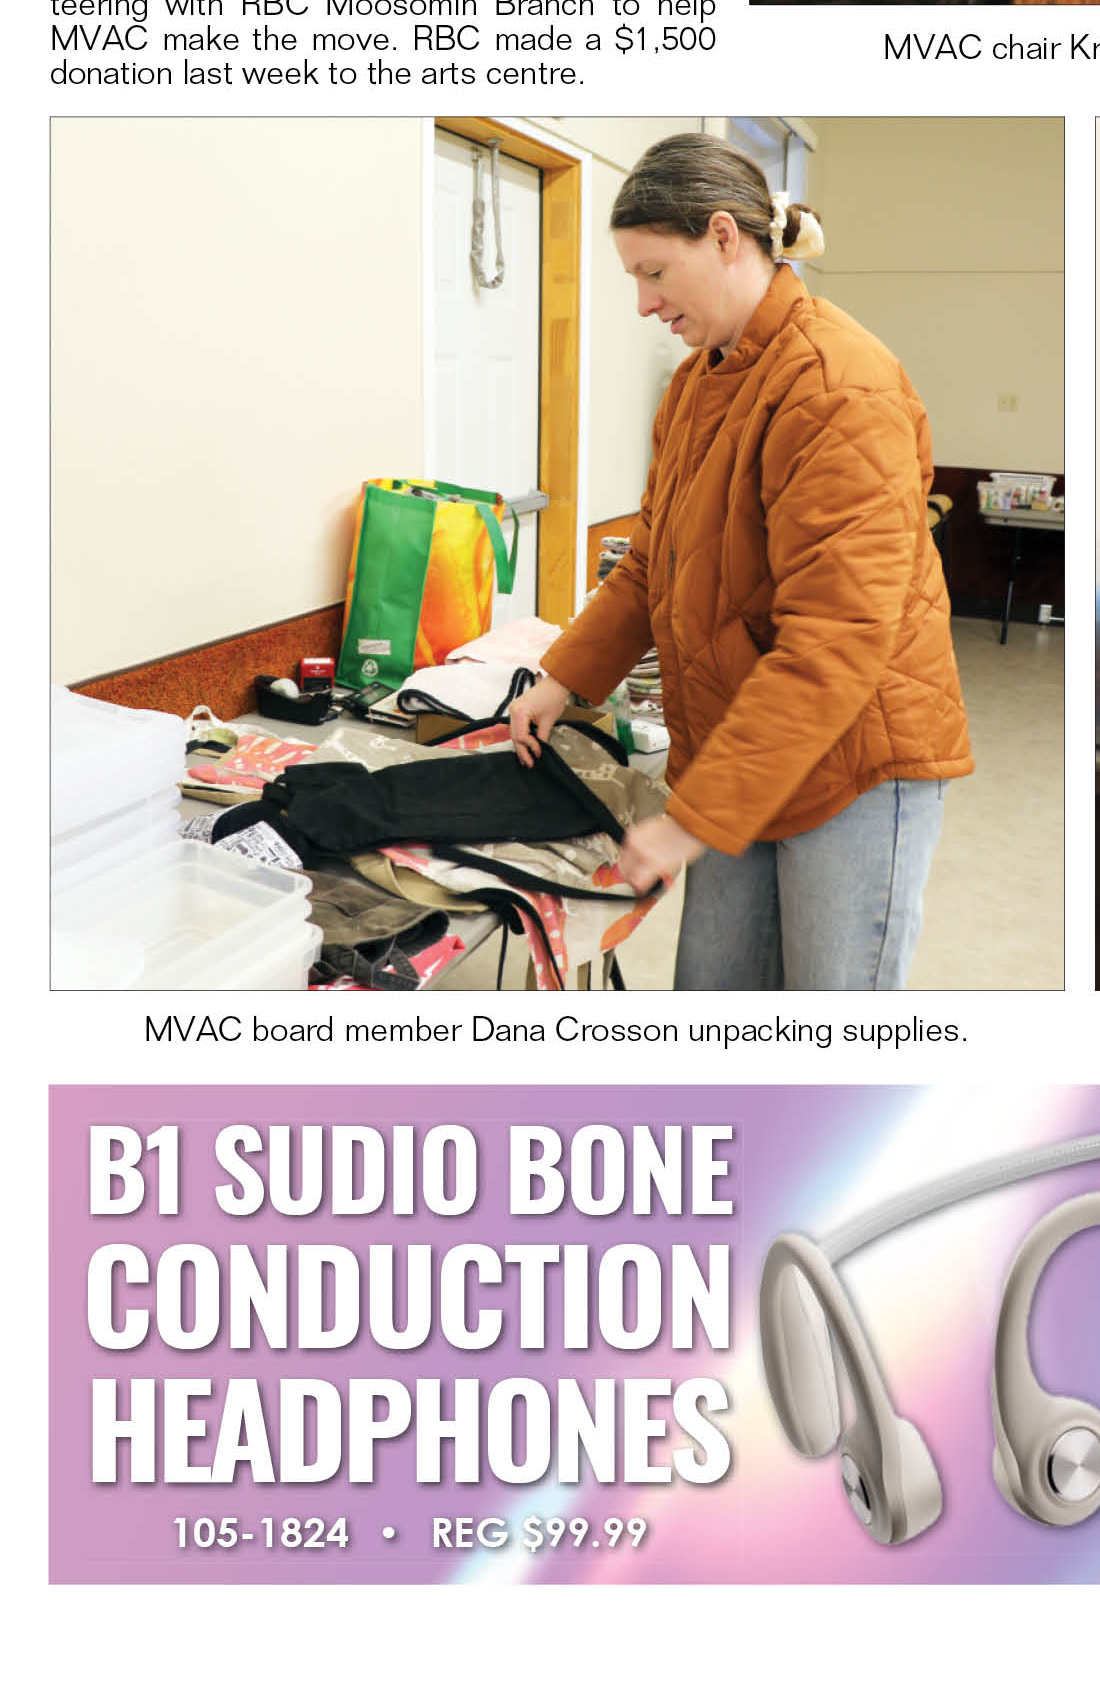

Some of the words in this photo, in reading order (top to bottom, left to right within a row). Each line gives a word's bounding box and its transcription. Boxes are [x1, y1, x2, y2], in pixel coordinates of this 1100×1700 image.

[52, 25, 147, 50] MVAC
[165, 25, 239, 50] make
[253, 25, 297, 50] the
[314, 34, 396, 50] move.
[415, 25, 479, 50] RBC
[497, 25, 572, 50] made
[586, 34, 600, 50] a
[616, 24, 715, 54] $1,500
[885, 34, 981, 59] MVAC
[993, 34, 1061, 59] chair
[146, 1016, 241, 1041] MVAC
[254, 1016, 332, 1041] board
[347, 1016, 462, 1041] member
[473, 1016, 544, 1041] Dana
[556, 1016, 677, 1041] Crosson
[690, 1016, 831, 1049] unpacking
[844, 1016, 966, 1049] supplies.
[91, 1126, 177, 1214] B1
[216, 1125, 476, 1215] SUDIO
[511, 1125, 732, 1215] BONE
[88, 1244, 728, 1349] CONDUCTION
[93, 1378, 730, 1483] HEADPHONES
[173, 1517, 349, 1548] 105-1824
[432, 1517, 508, 1548] REG
[523, 1515, 648, 1553] $99.99
